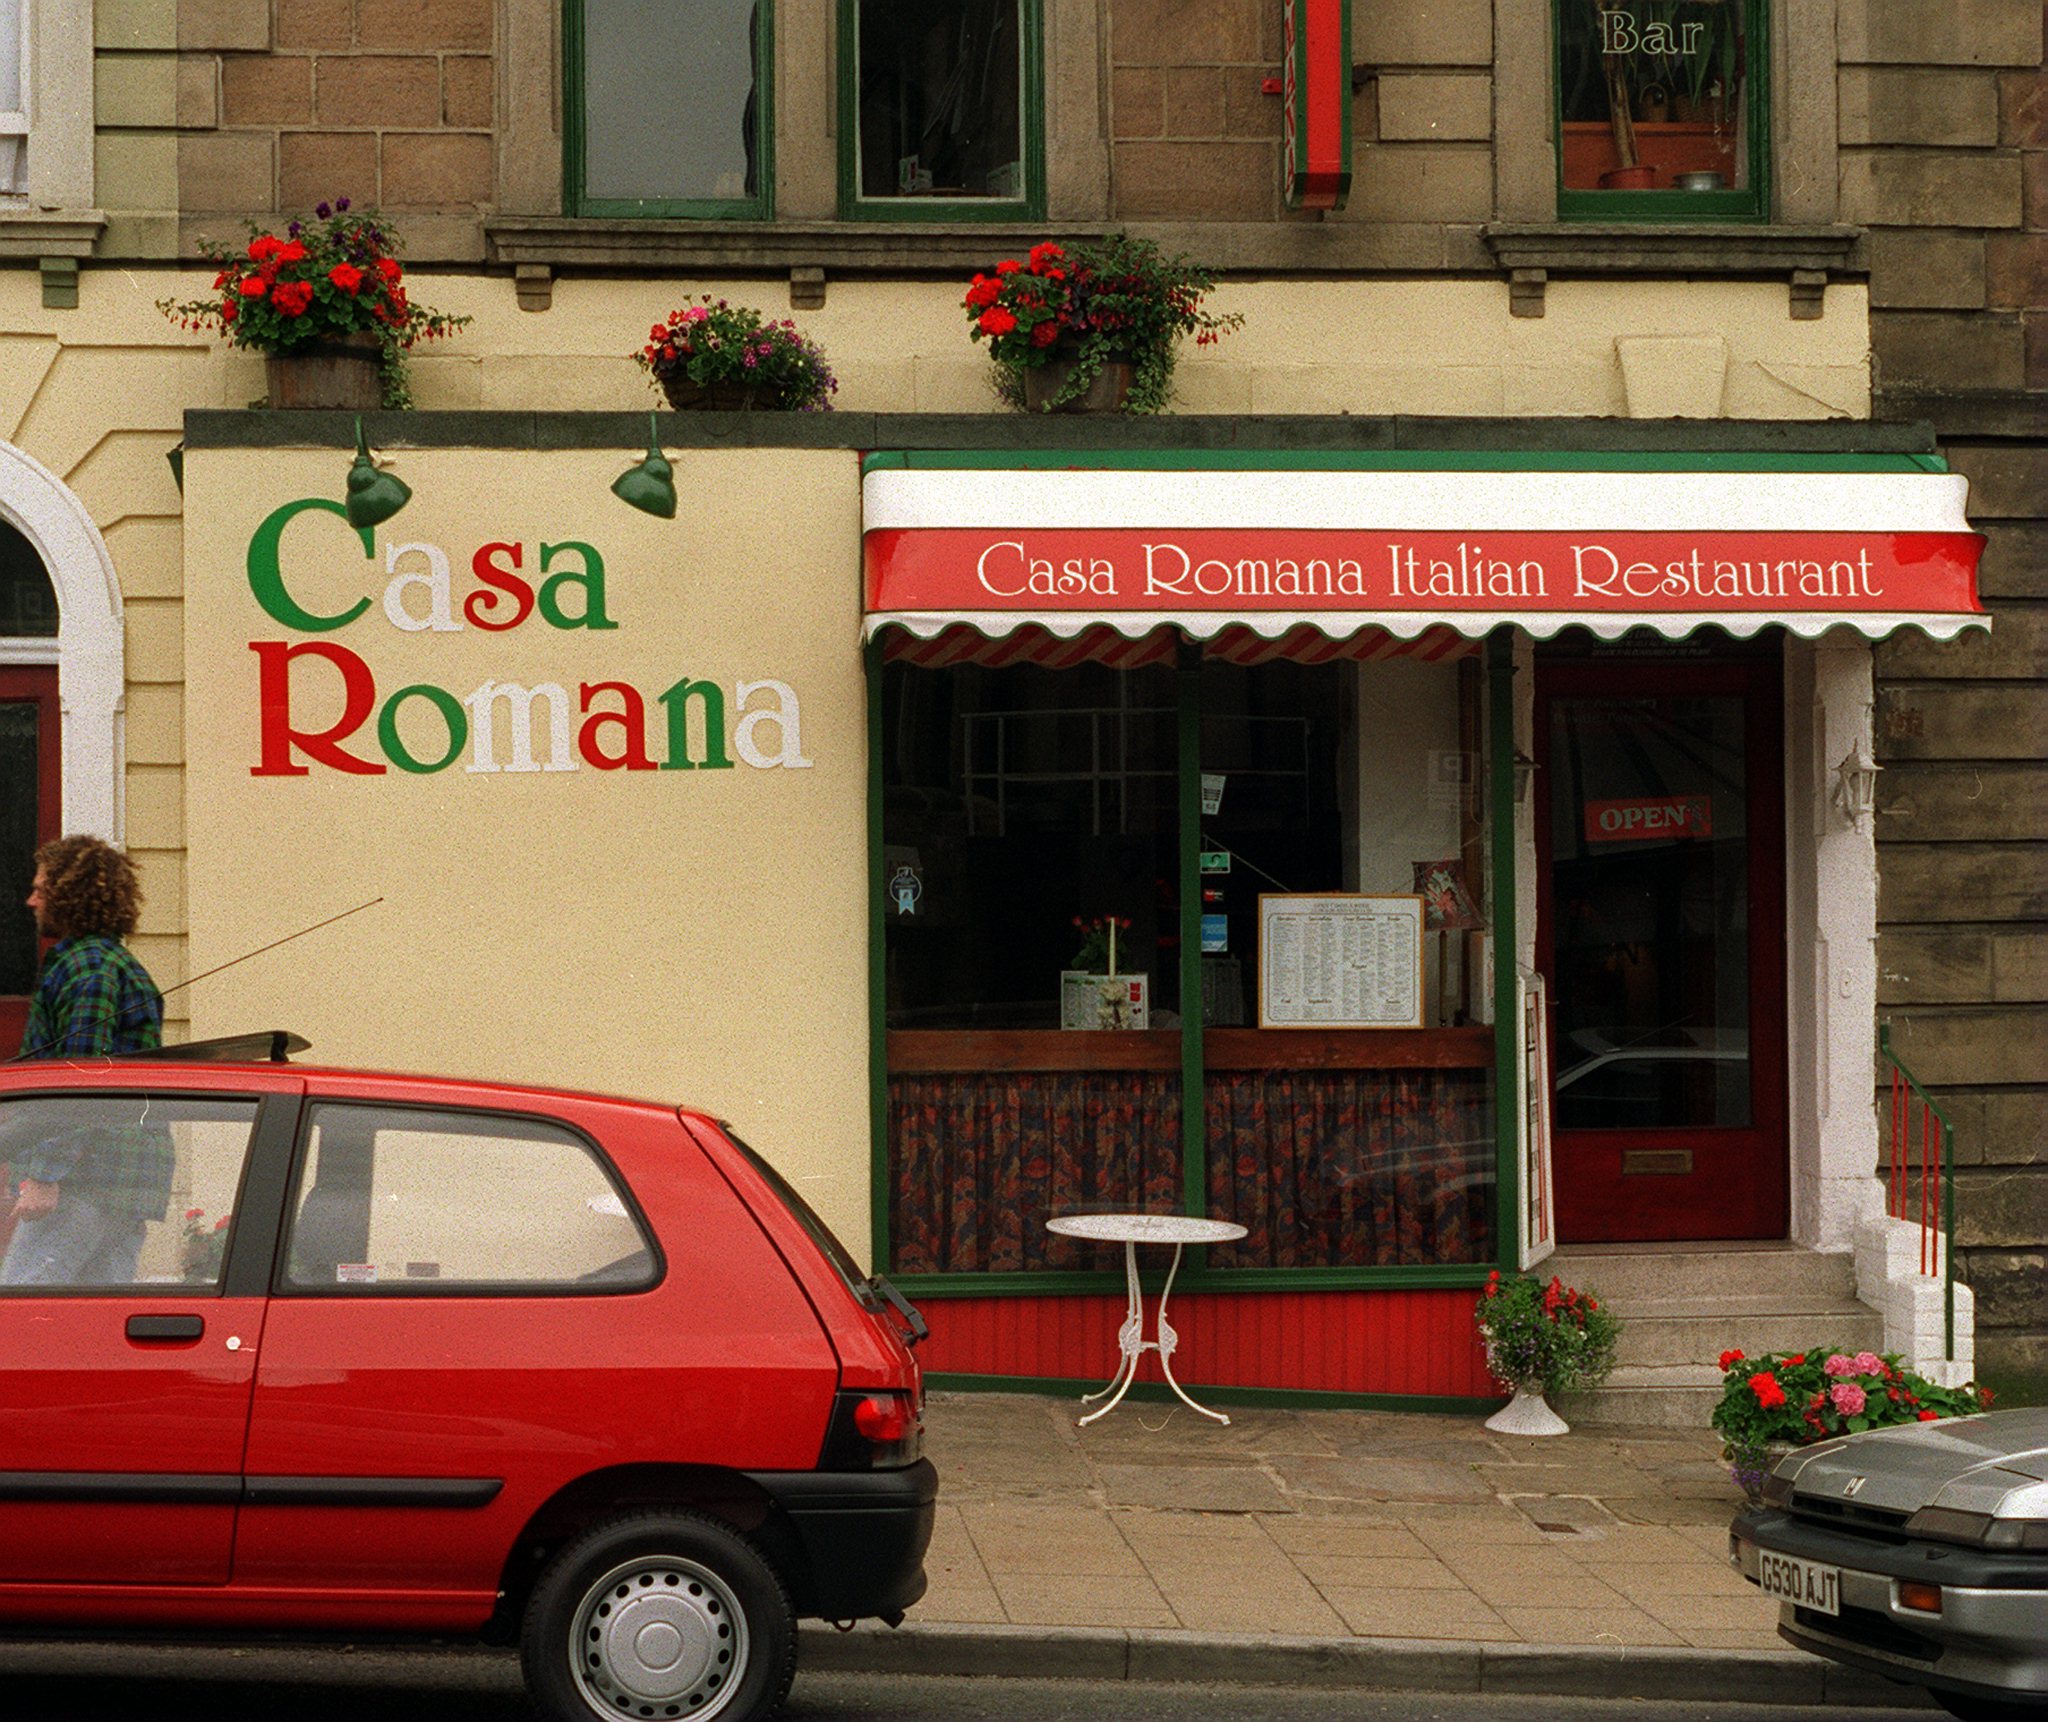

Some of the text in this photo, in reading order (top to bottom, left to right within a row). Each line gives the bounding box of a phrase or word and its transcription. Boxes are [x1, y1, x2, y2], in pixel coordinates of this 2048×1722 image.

[1601, 11, 1704, 54] Bar
[247, 498, 618, 632] Casa
[978, 541, 1883, 596] Casa Romana Italian Restaurant
[248, 641, 813, 777] Romana
[1600, 805, 1687, 831] OPEN
[1762, 1555, 1836, 1611] G530 AJT
